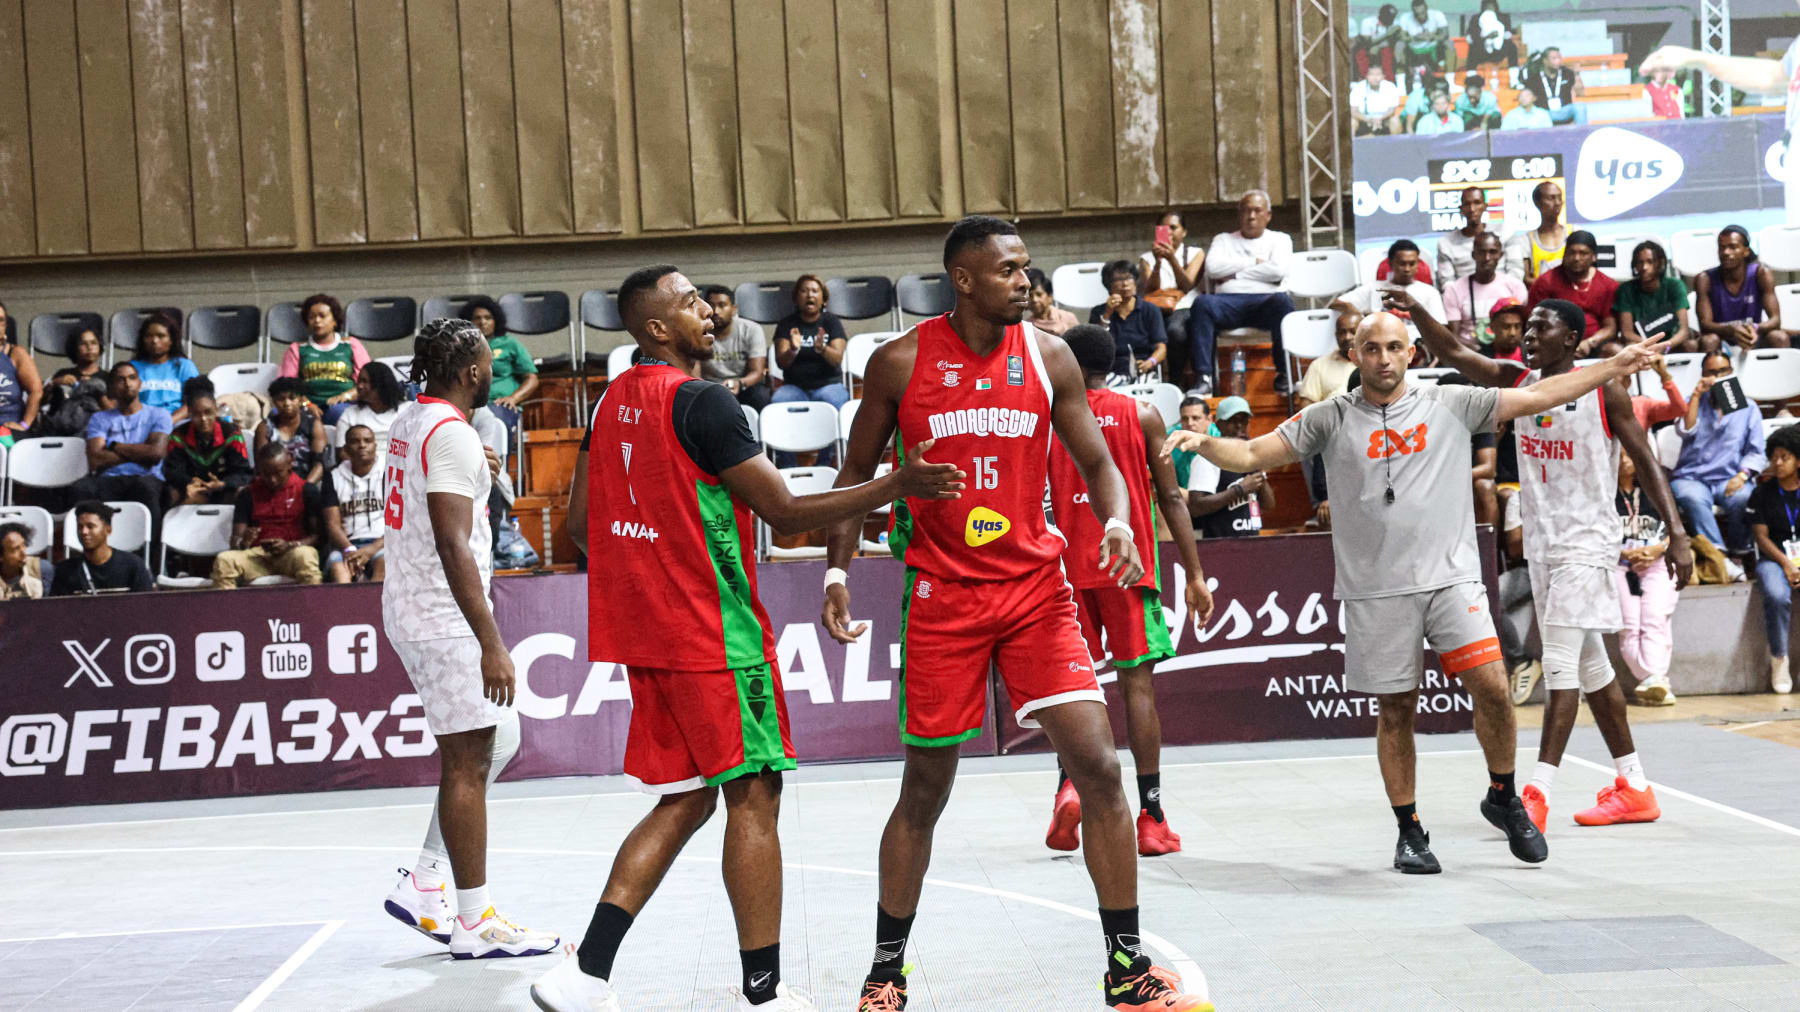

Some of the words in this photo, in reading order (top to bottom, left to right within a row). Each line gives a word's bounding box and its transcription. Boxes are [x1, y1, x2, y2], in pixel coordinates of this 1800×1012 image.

[1594, 158, 1662, 194] yas
[618, 404, 642, 424] ELY
[928, 407, 1039, 439] MADAGASCAR
[972, 456, 999, 489] 15
[1541, 464, 1547, 484] 1
[972, 520, 1003, 537] yas
[268, 619, 300, 643] You
[266, 650, 308, 672] Tube
[0, 694, 439, 777] @FIBA3x3
